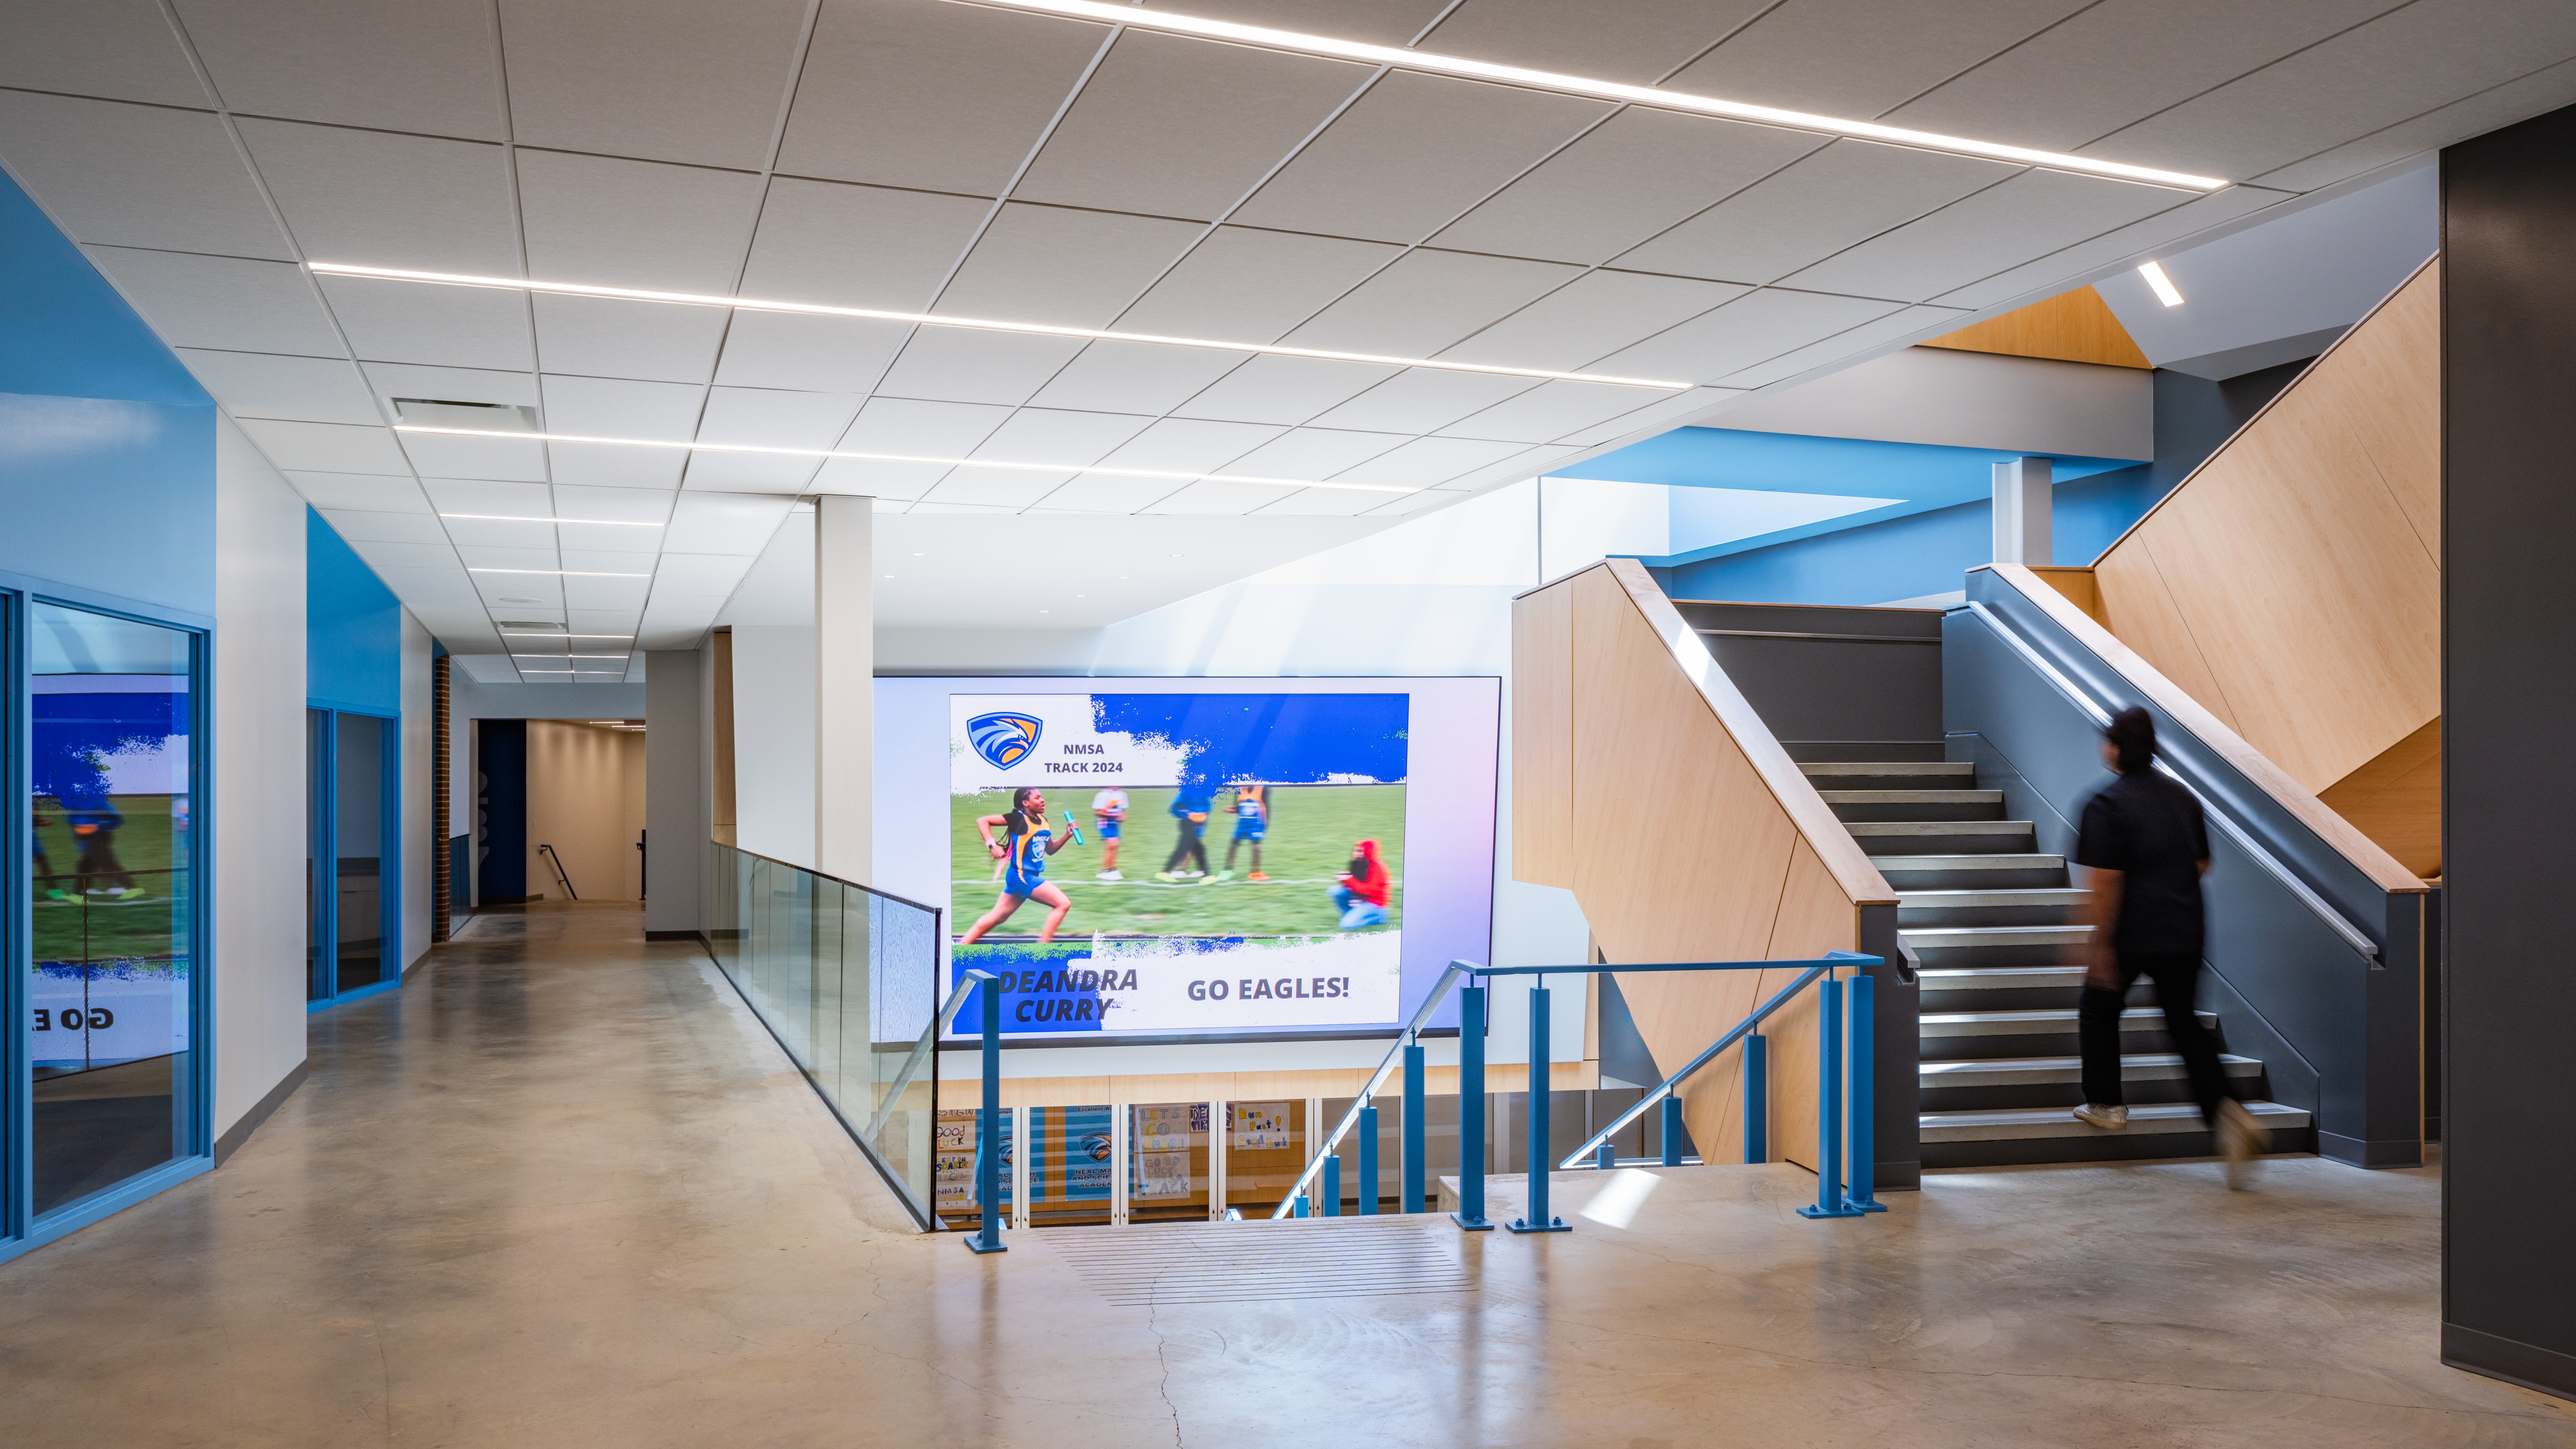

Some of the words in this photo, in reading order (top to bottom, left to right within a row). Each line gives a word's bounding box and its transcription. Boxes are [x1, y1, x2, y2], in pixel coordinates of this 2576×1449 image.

[1064, 744, 1105, 754] NMSA
[1045, 763, 1089, 773] TRACK
[1092, 762, 1123, 772] 2024
[999, 969, 1138, 993] DEANDRA
[1188, 980, 1229, 1001] GO
[1239, 977, 1349, 1000] EAGLES!
[1016, 998, 1115, 1022] CURRY
[1239, 1109, 1262, 1119] Run
[1146, 1123, 1170, 1136] GO
[1250, 1120, 1271, 1131] Fast
[938, 1137, 963, 1149] LUCK
[1145, 1156, 1180, 1168] GOOD
[938, 1187, 964, 1195] NMSA
